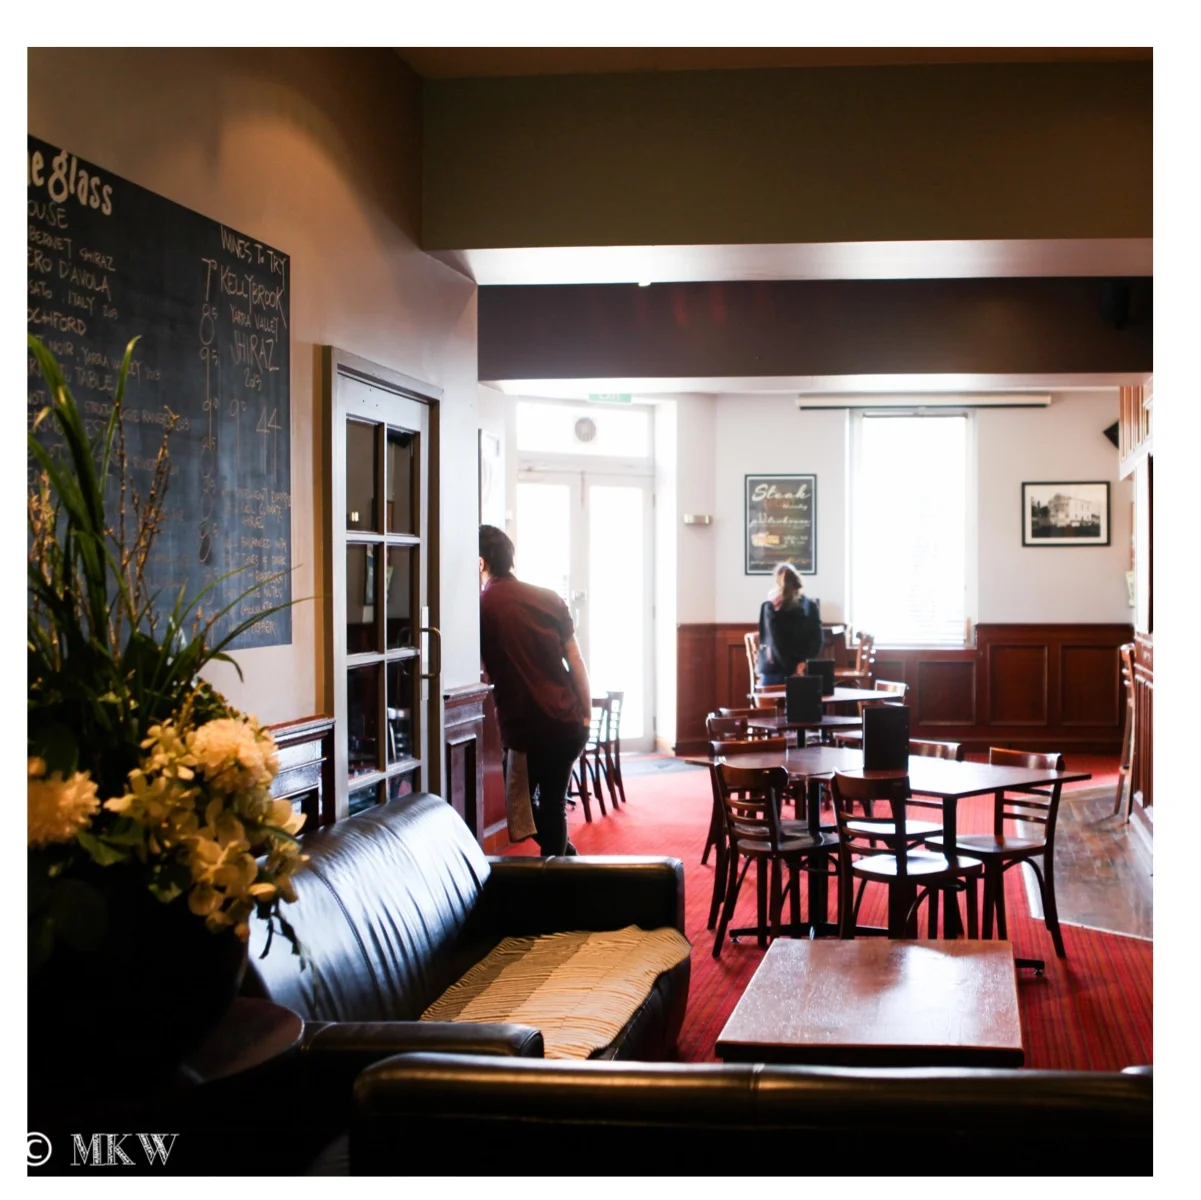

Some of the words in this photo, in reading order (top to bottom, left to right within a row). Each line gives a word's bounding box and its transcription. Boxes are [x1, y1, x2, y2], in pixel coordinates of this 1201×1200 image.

[48, 150, 112, 215] glass
[79, 248, 116, 272] SHIRAZ
[220, 225, 253, 263] WINES
[267, 250, 286, 291] TRY
[59, 259, 111, 302] D'AVOLA
[220, 264, 287, 329] KELLYBROOK
[68, 290, 95, 316] ITALY
[229, 303, 252, 328] YARRA
[254, 313, 279, 342] VALLEY
[229, 329, 280, 375] SHIRAZ
[75, 366, 114, 391] TABLE
